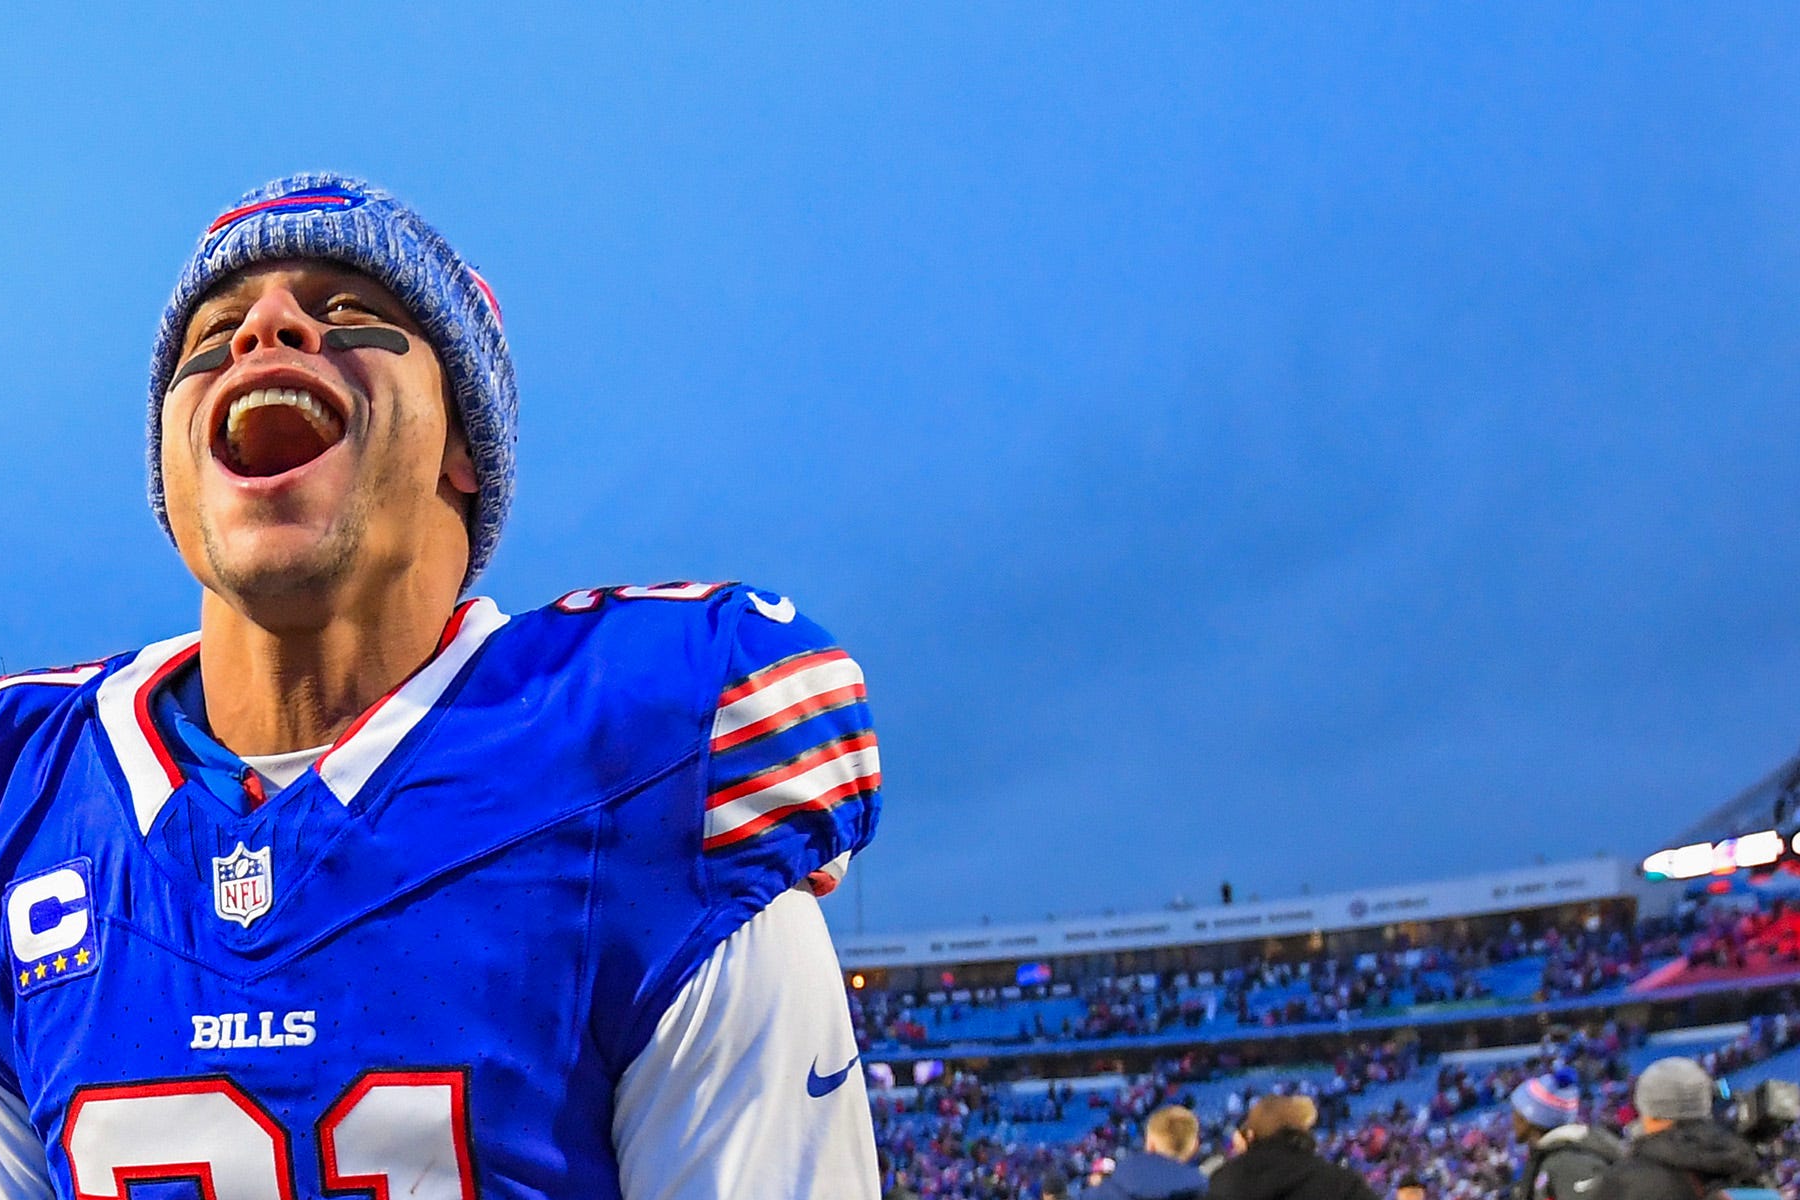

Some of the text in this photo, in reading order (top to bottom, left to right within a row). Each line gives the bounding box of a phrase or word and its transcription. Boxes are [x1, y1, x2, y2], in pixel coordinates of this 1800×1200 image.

[224, 878, 263, 910] NFL
[7, 868, 89, 963] C
[190, 1010, 317, 1049] BILLS
